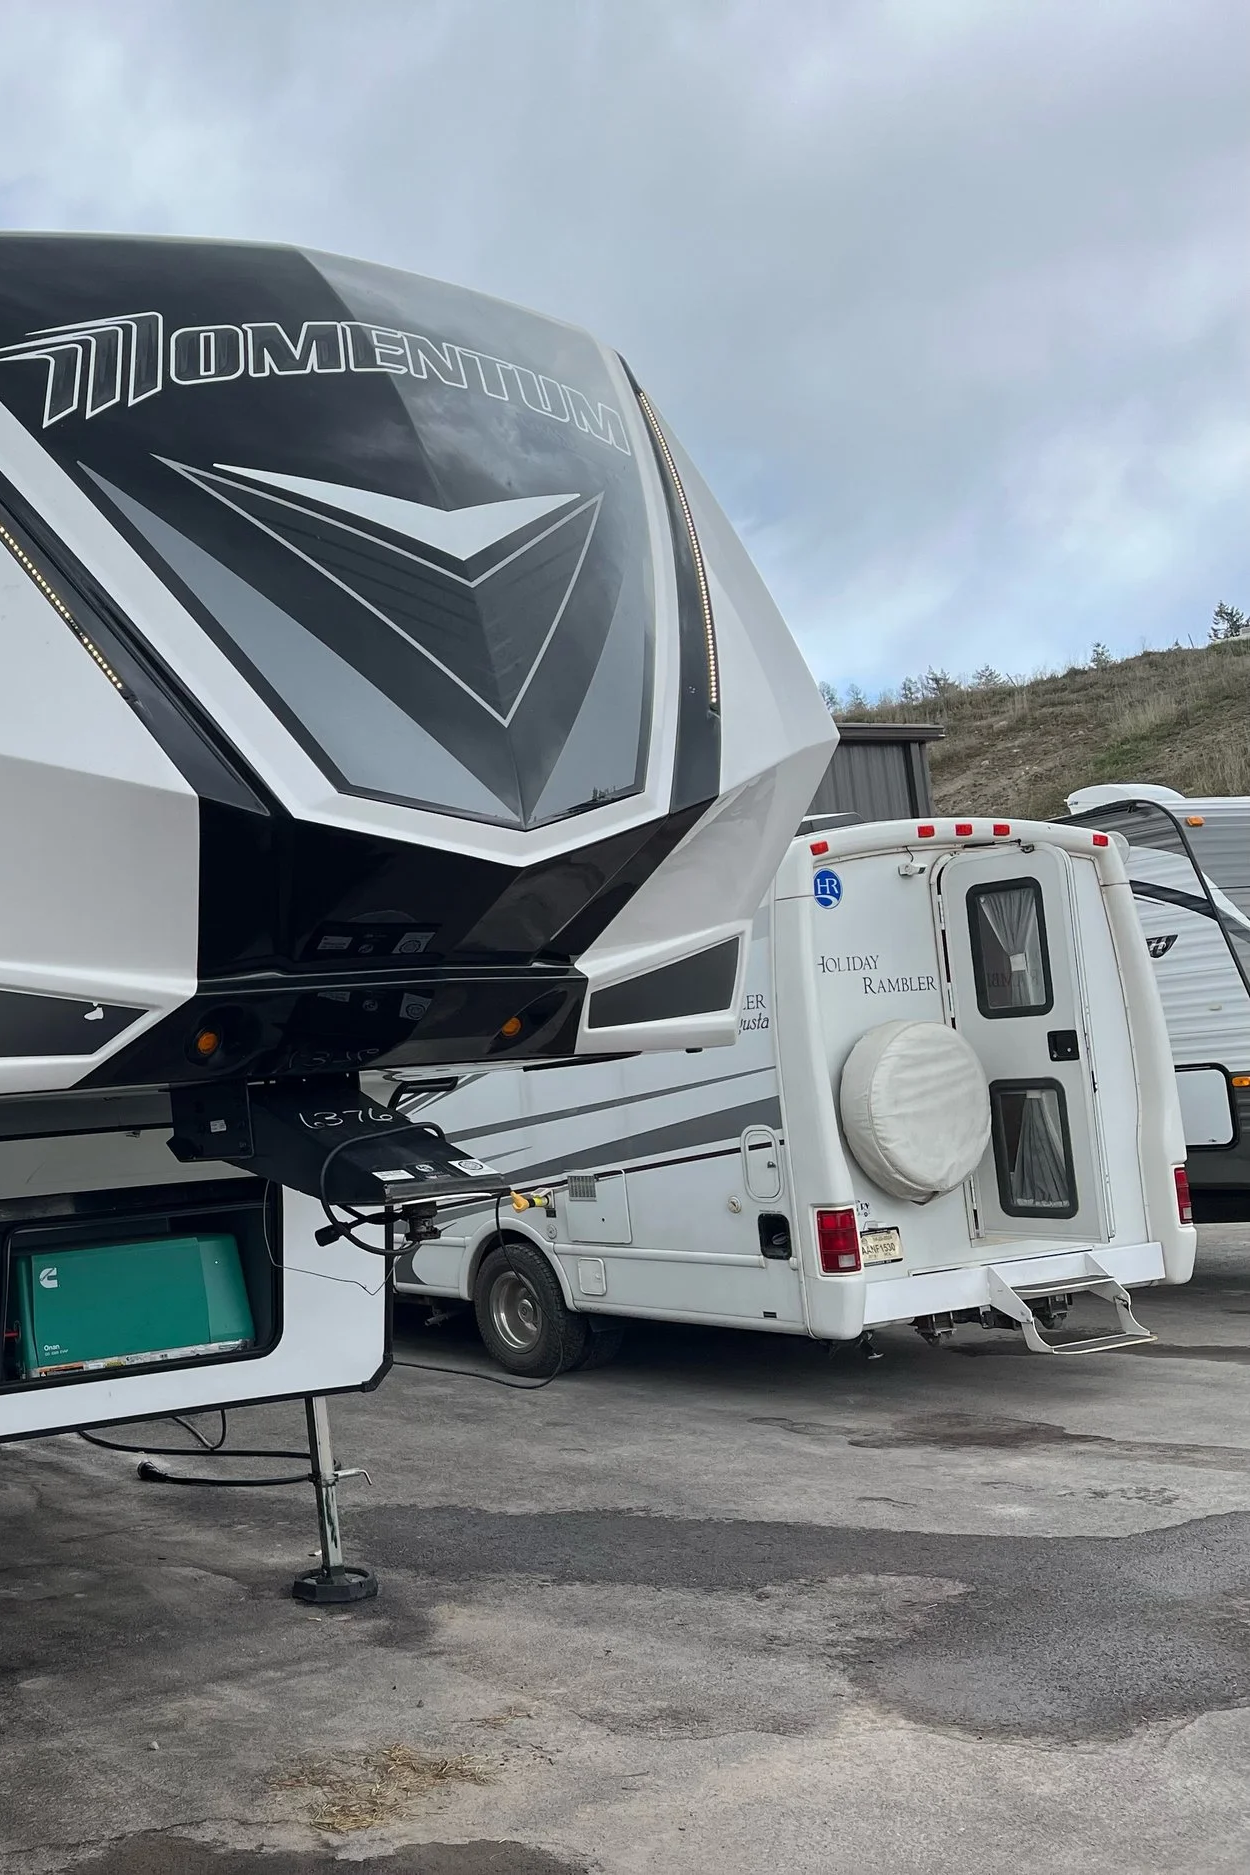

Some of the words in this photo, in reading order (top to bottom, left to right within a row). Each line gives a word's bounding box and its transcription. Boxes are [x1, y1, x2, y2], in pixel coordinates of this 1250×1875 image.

[816, 877, 839, 895] HR
[863, 976, 937, 995] RAMBLER
[742, 993, 767, 1011] ER
